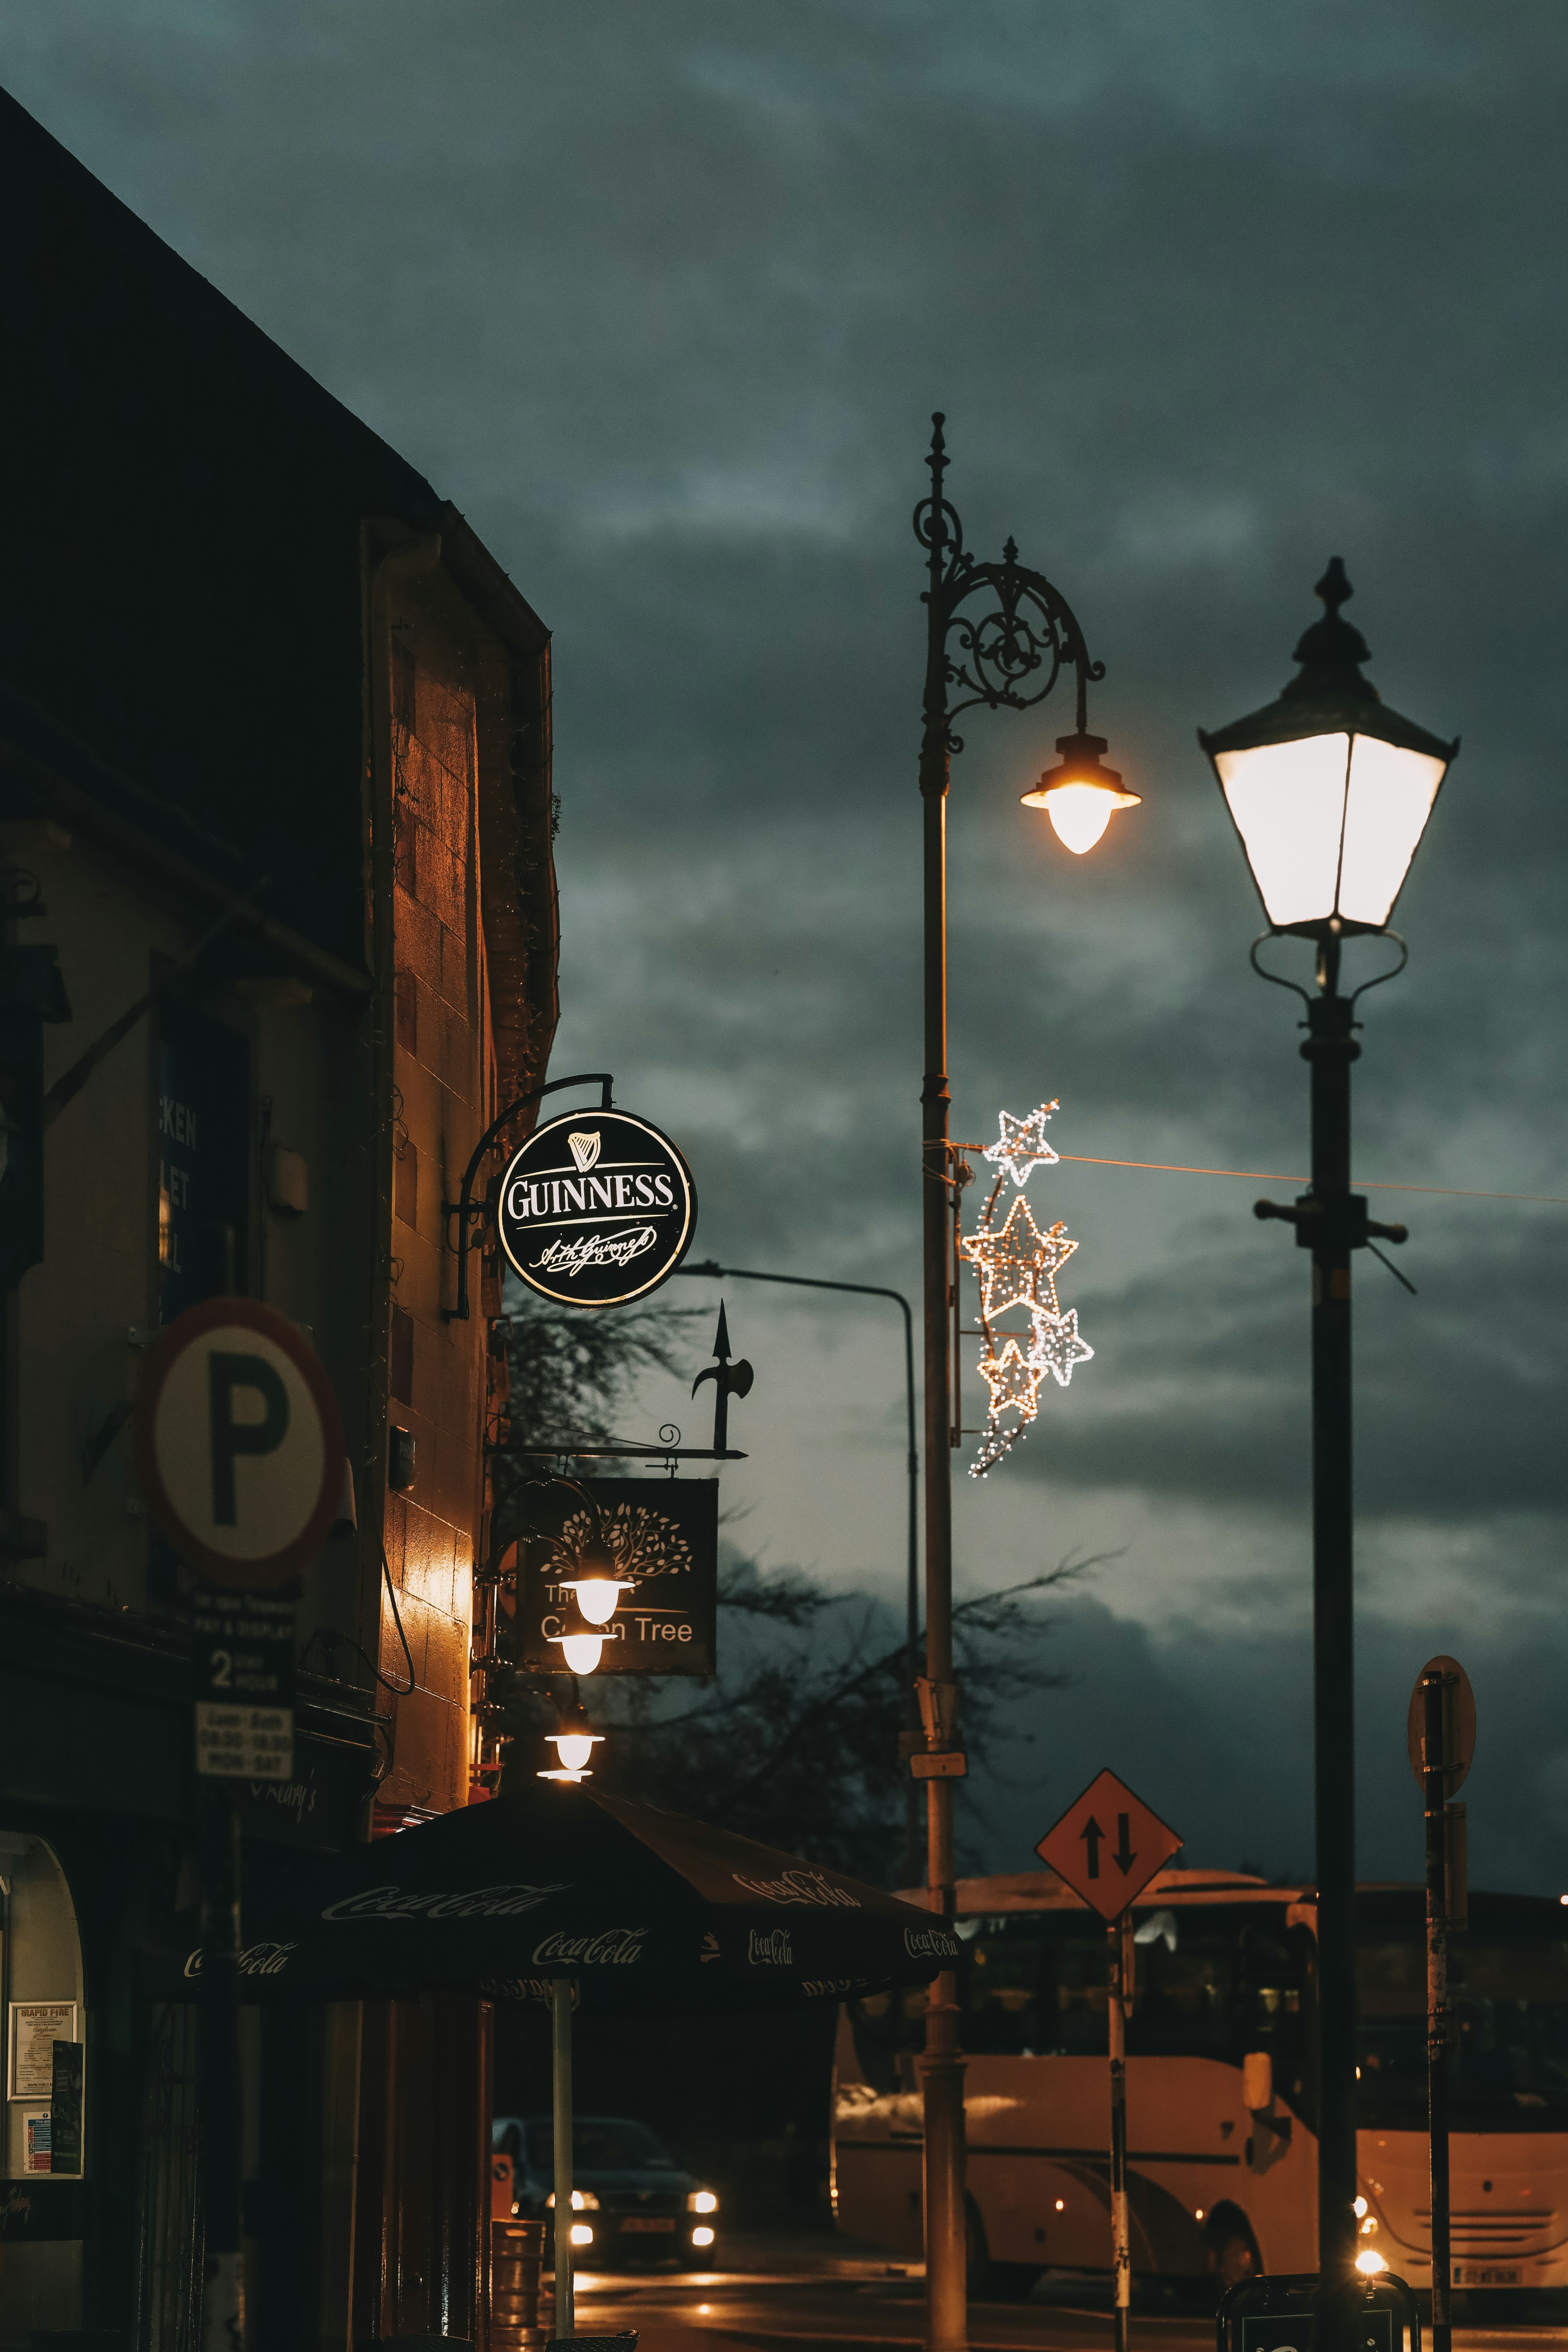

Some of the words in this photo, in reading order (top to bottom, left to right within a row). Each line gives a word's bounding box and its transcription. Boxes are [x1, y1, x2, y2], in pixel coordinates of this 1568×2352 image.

[508, 1174, 673, 1219] GUINNESS
[209, 1352, 289, 1526] P
[635, 1617, 693, 1641] Tree
[210, 1649, 232, 1688] 2
[321, 1883, 575, 1920] Coca-Cola
[732, 1871, 861, 1907] Coca-Cola
[532, 1929, 649, 1964] Coca-Cola
[748, 1929, 793, 1965] Coca-Cola
[904, 1928, 958, 1958] Coca-Cola
[50, 2008, 69, 2016] FIRE
